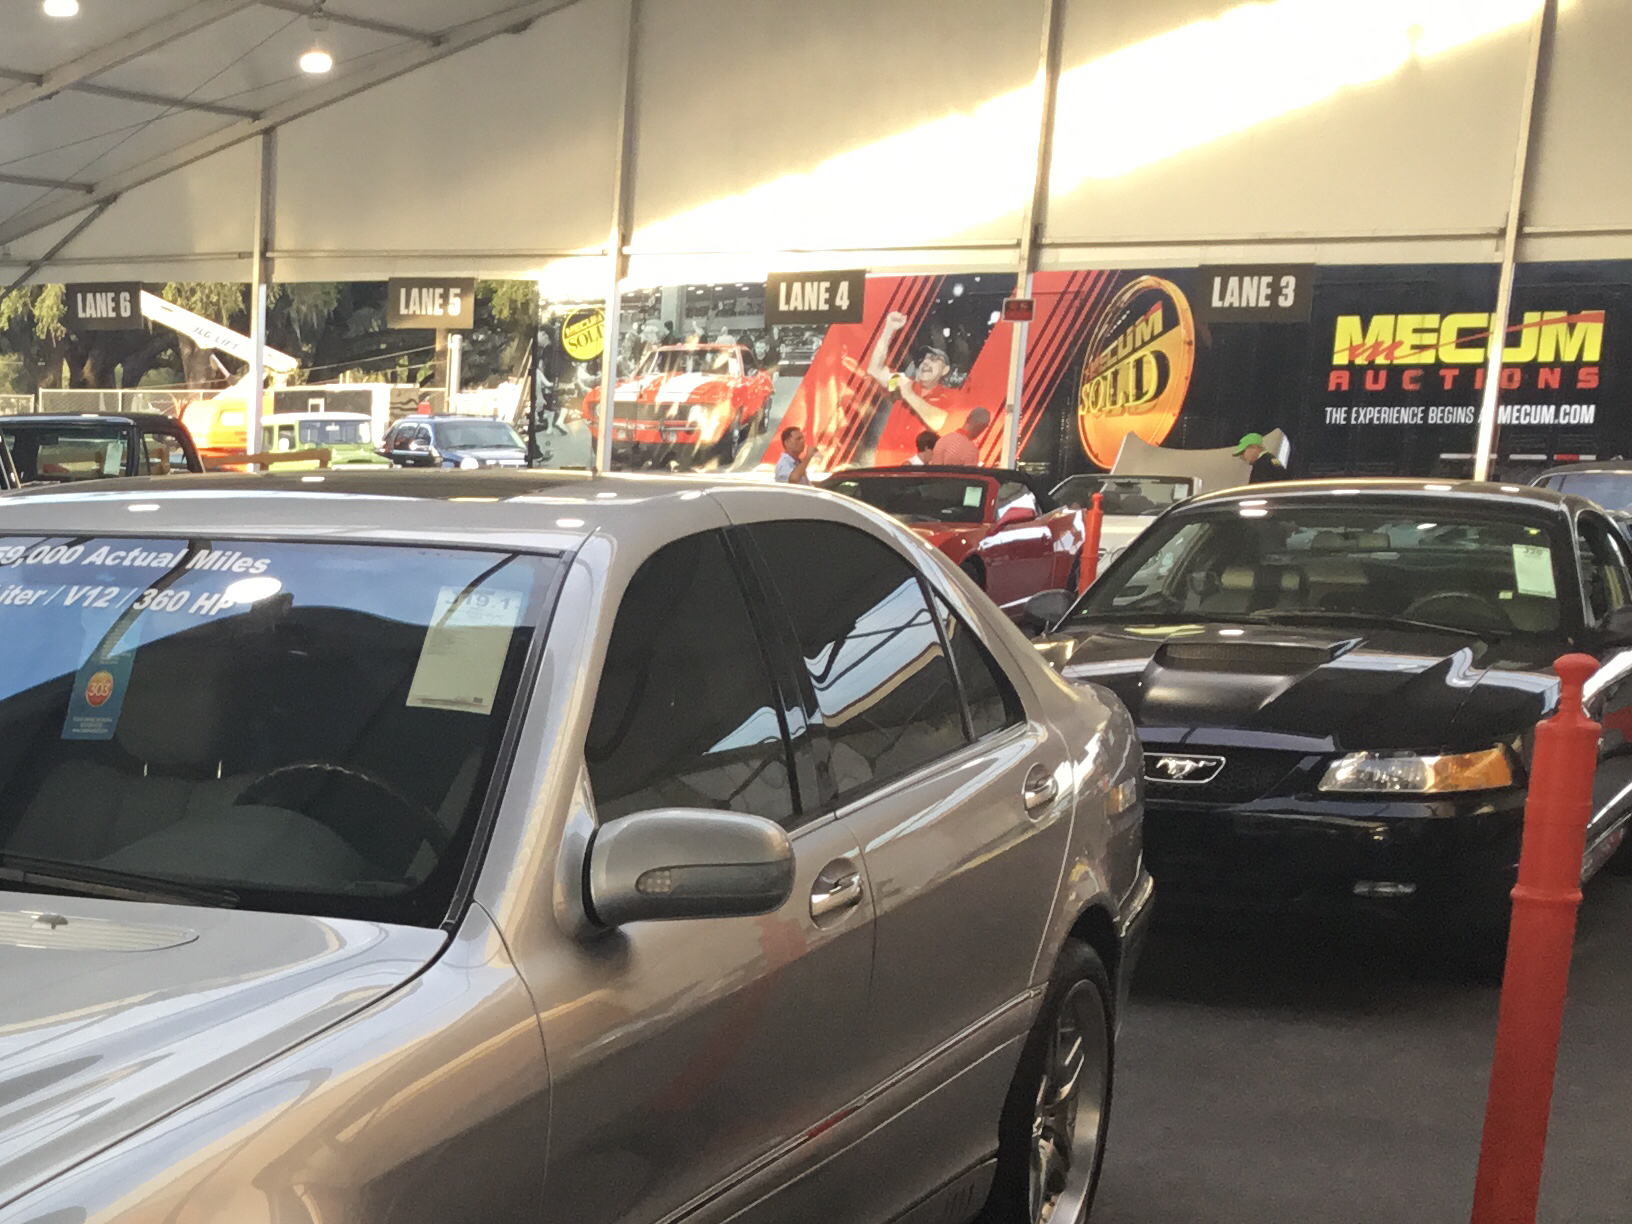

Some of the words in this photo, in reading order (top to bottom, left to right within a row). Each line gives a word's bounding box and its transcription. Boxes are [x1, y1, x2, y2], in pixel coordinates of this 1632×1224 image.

[76, 292, 117, 318] LANE
[119, 291, 132, 317] 6
[399, 287, 444, 315] LANE
[447, 287, 462, 316] 5
[779, 281, 831, 311] LANE
[835, 281, 850, 310] 4
[1211, 276, 1273, 307] LANE
[1278, 275, 1297, 307] 3
[1332, 310, 1606, 366] MECUM
[1078, 349, 1171, 415] SOLD
[1327, 366, 1600, 392] AUCTIONS
[1324, 407, 1348, 425] THE
[1351, 407, 1425, 425] EXPERIENCE
[1428, 406, 1475, 424] BEGINS
[1497, 404, 1596, 424] MECUM.COM
[81, 545, 185, 569] Actual
[186, 548, 272, 574] Miles
[62, 584, 121, 608] V12
[133, 588, 191, 612] 360
[188, 592, 235, 616] HP
[88, 682, 110, 696] 303
